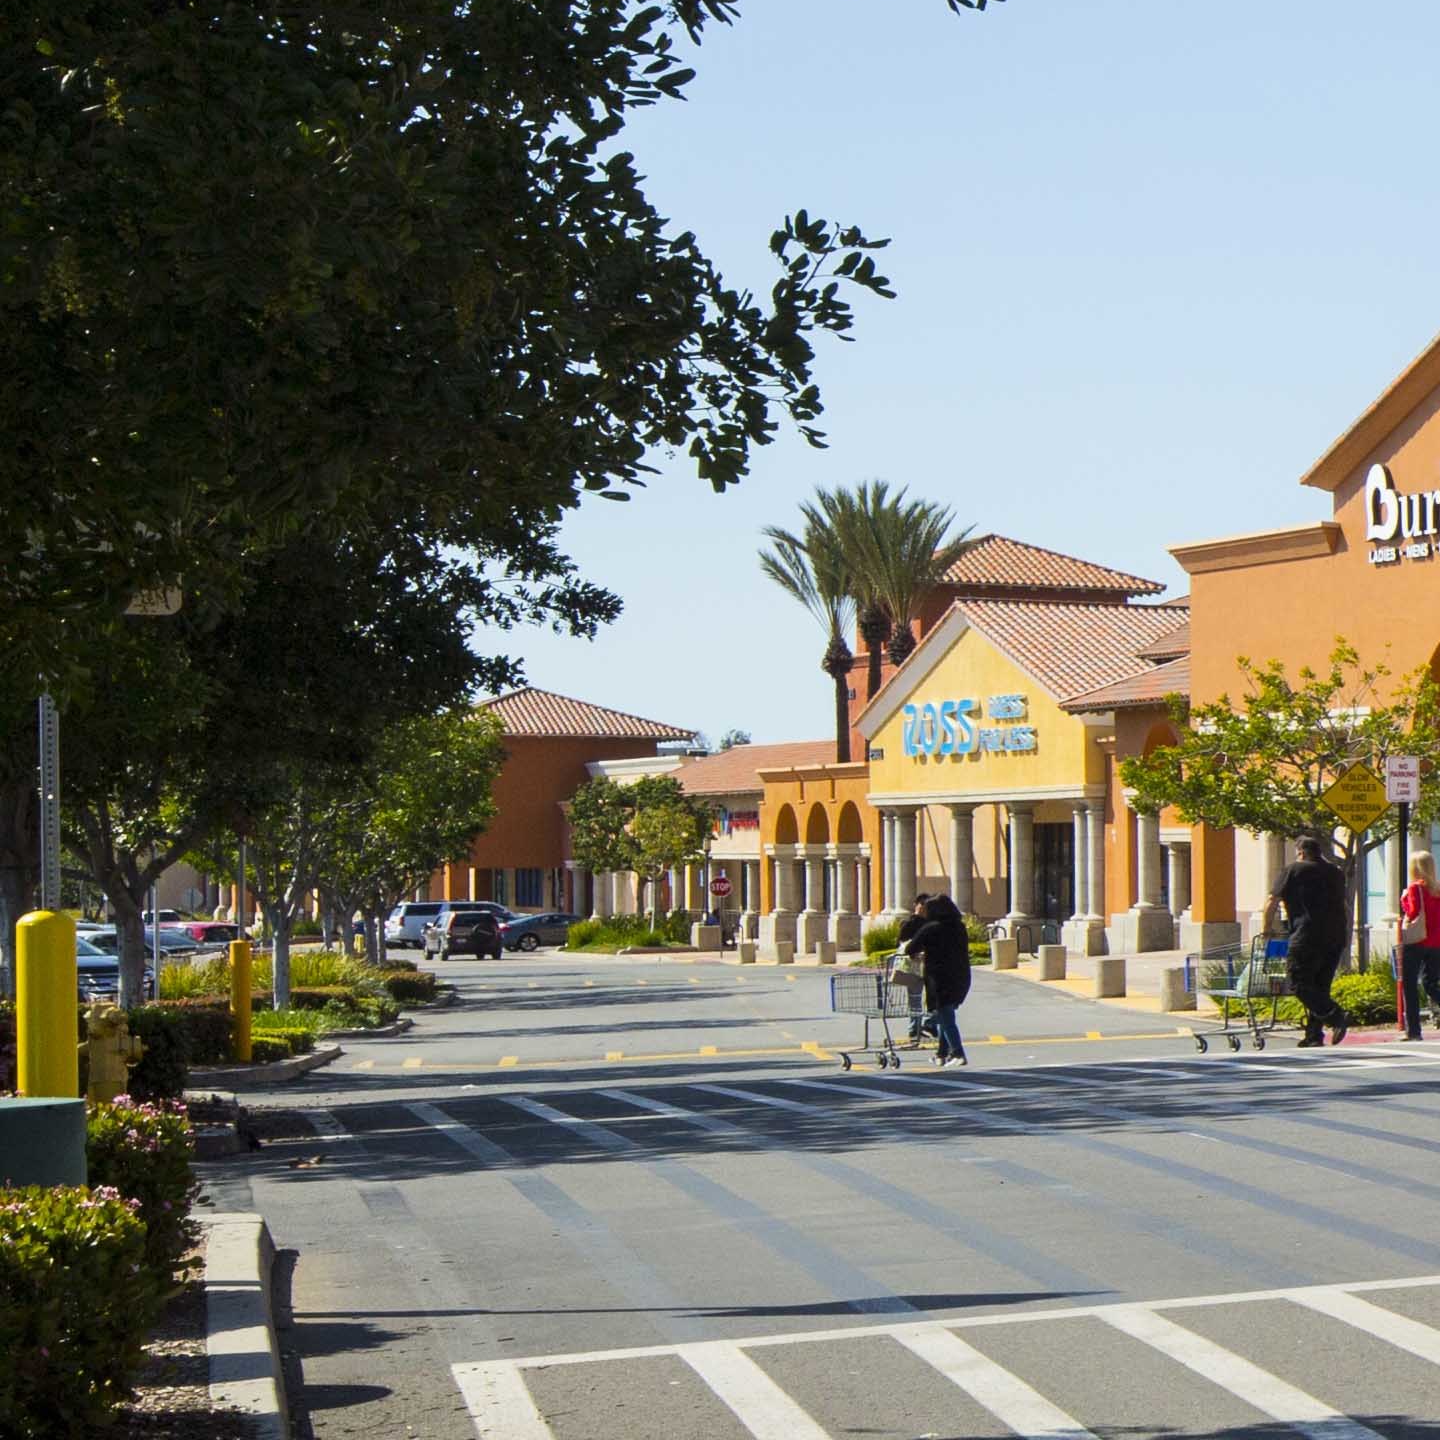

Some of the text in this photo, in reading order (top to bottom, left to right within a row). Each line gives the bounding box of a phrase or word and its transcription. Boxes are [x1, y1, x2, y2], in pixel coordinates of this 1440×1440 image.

[1368, 547, 1396, 564] LADIES
[1405, 543, 1428, 559] MENS
[904, 698, 977, 757] ROSS
[1348, 773, 1369, 781] SLOW
[1341, 783, 1377, 792] VEHICLES
[1351, 793, 1367, 801] AND
[1336, 803, 1381, 811] PEDESTRIAN
[711, 883, 729, 891] STOP
